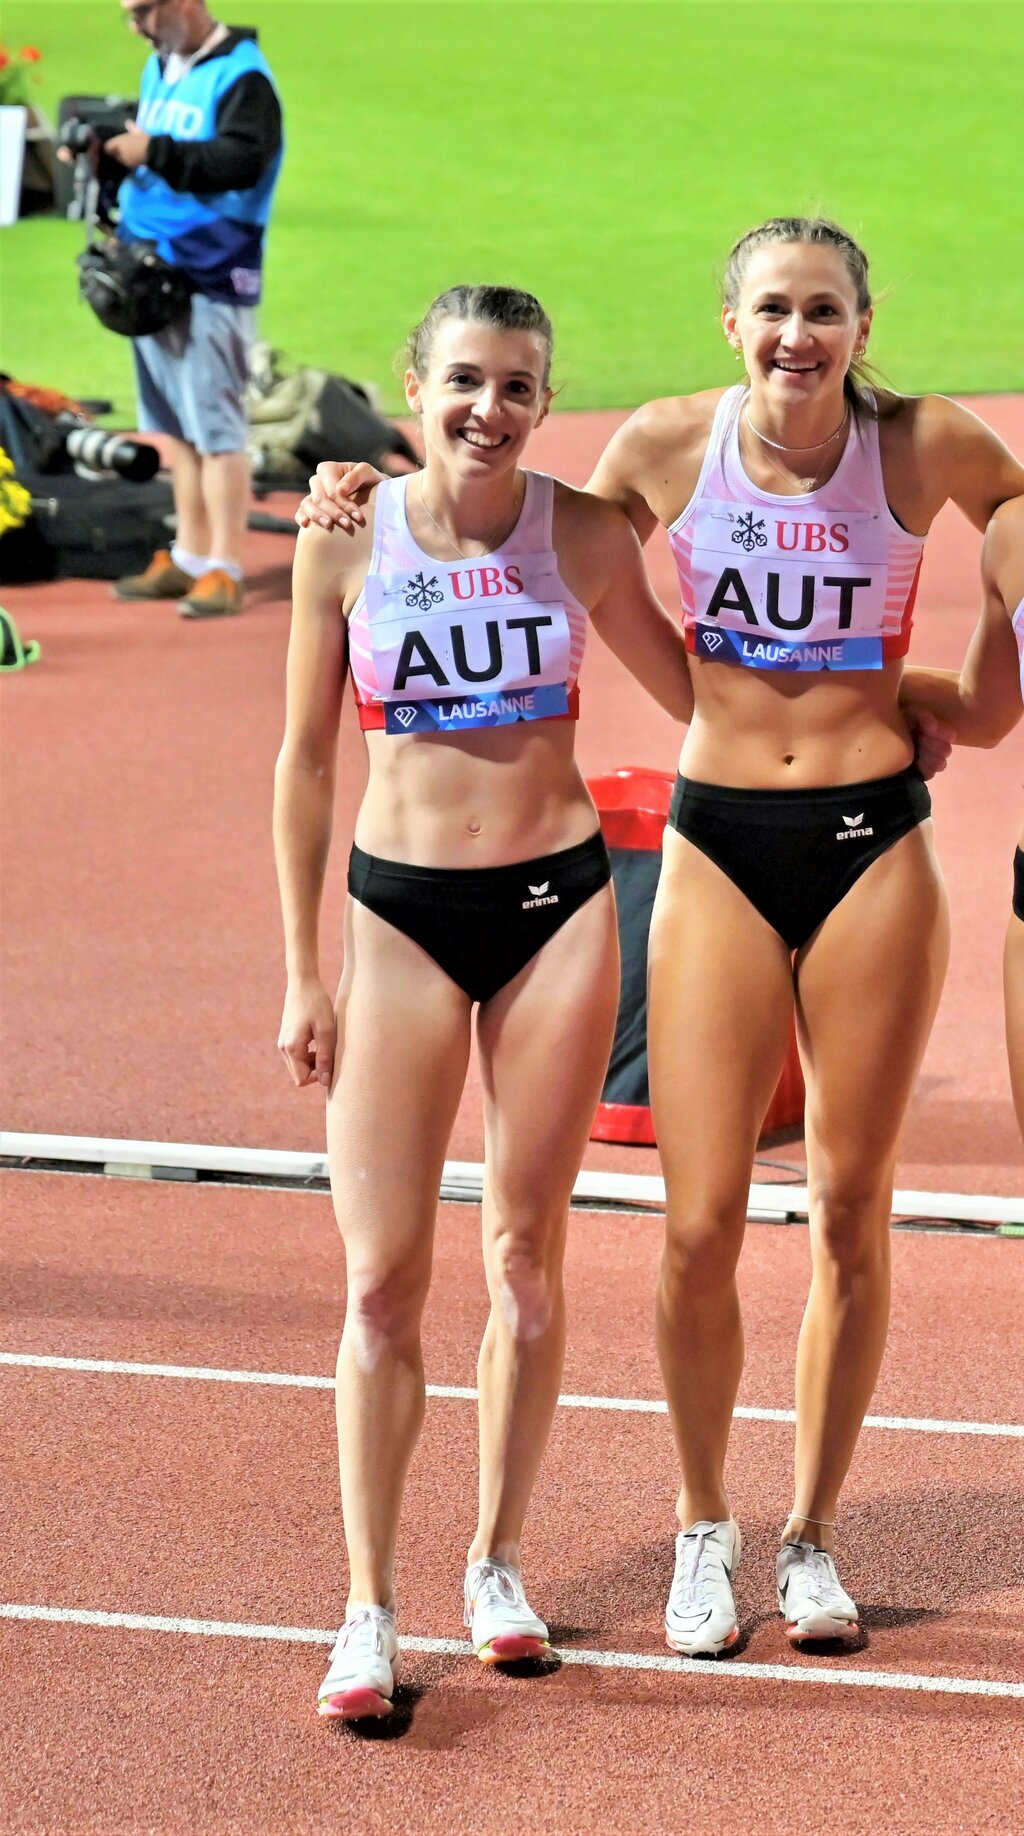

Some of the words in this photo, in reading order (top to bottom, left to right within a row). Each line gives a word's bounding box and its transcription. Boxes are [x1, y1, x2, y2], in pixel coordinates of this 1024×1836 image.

[775, 520, 850, 553] UBS
[448, 565, 524, 601] UBS
[705, 567, 872, 631] AUT
[393, 616, 553, 690] AUT
[742, 641, 844, 663] LAUSANNE
[438, 695, 535, 721] LAUSANNE
[836, 827, 874, 840] erima
[522, 894, 559, 910] erima
